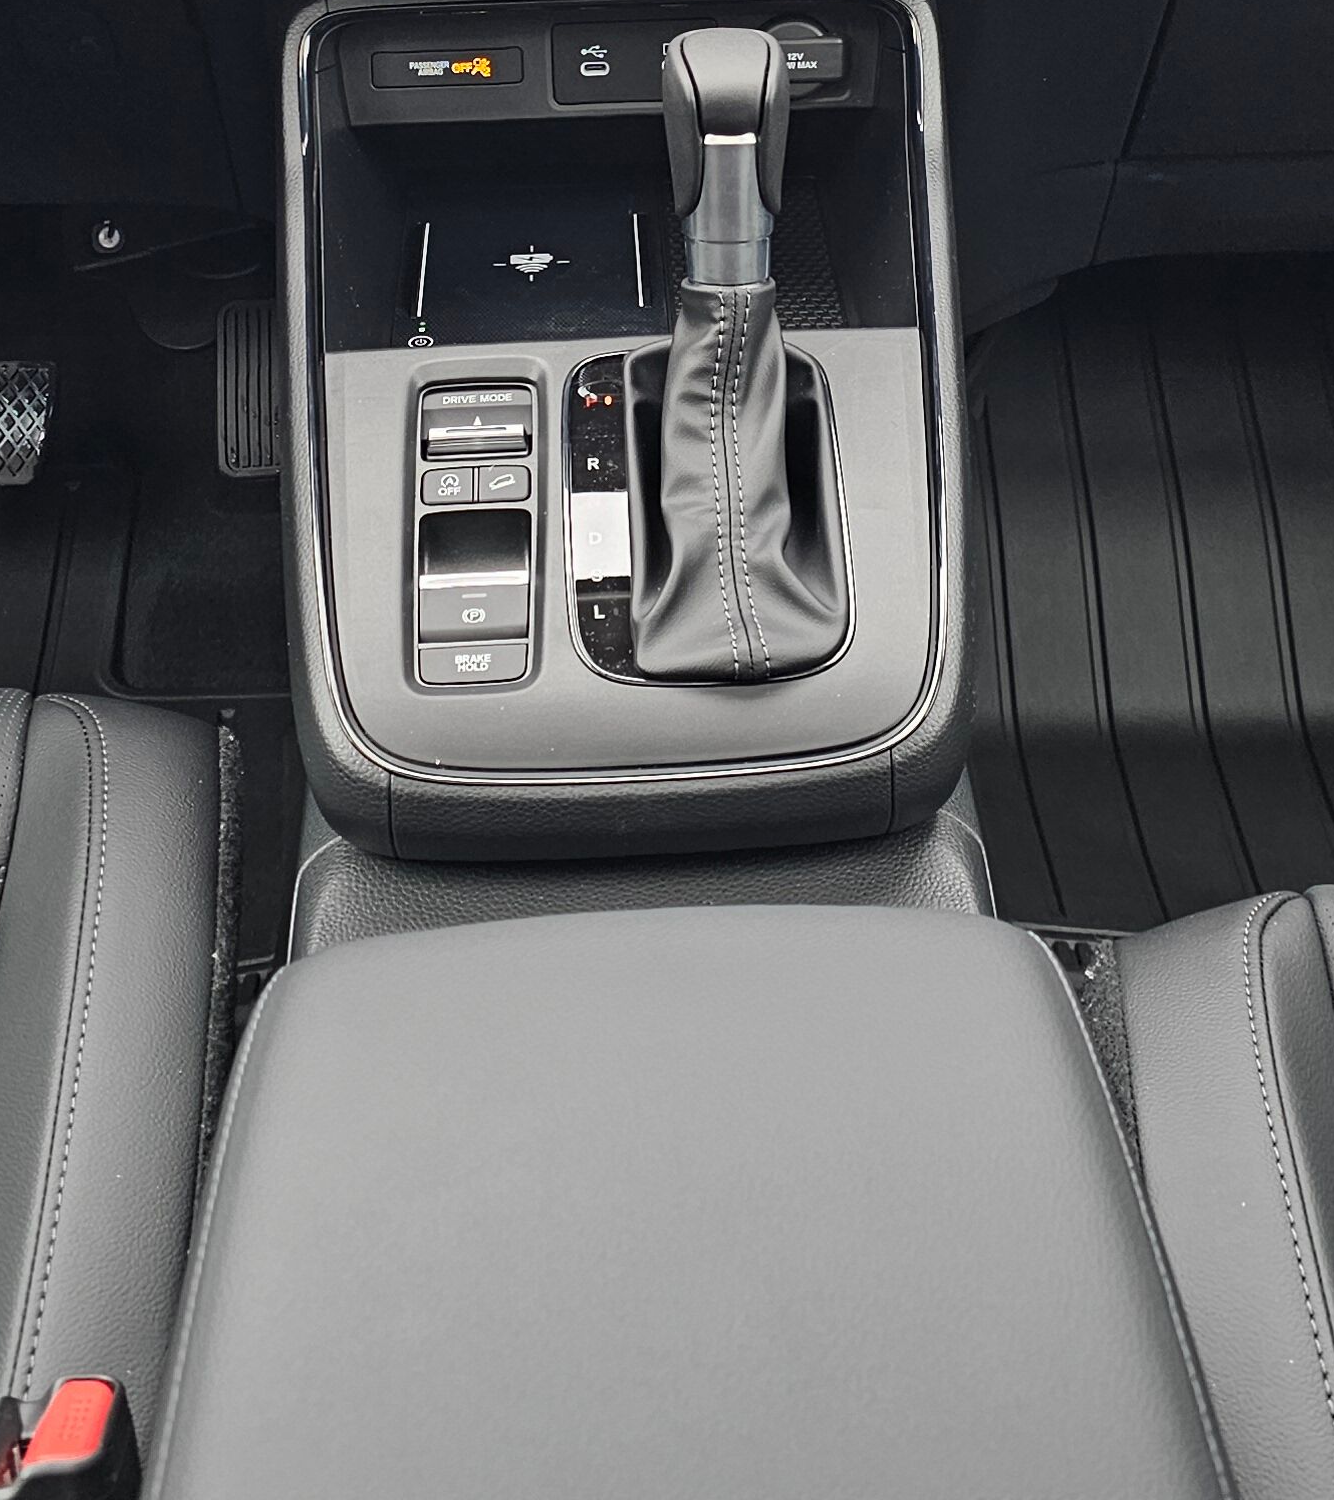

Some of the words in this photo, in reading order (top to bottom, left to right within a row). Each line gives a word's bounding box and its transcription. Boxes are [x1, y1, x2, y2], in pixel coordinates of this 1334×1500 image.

[787, 52, 804, 61] 12V
[409, 61, 450, 70] PASSENGER
[451, 62, 473, 74] OFF
[797, 60, 818, 69] MAX
[442, 394, 477, 405] DRIVE
[480, 393, 513, 403] MODE
[587, 457, 600, 471] R
[438, 487, 461, 496] OFF
[589, 531, 603, 545] D
[593, 605, 606, 620] L
[455, 653, 491, 664] BRAKE
[457, 662, 489, 673] HOLD
